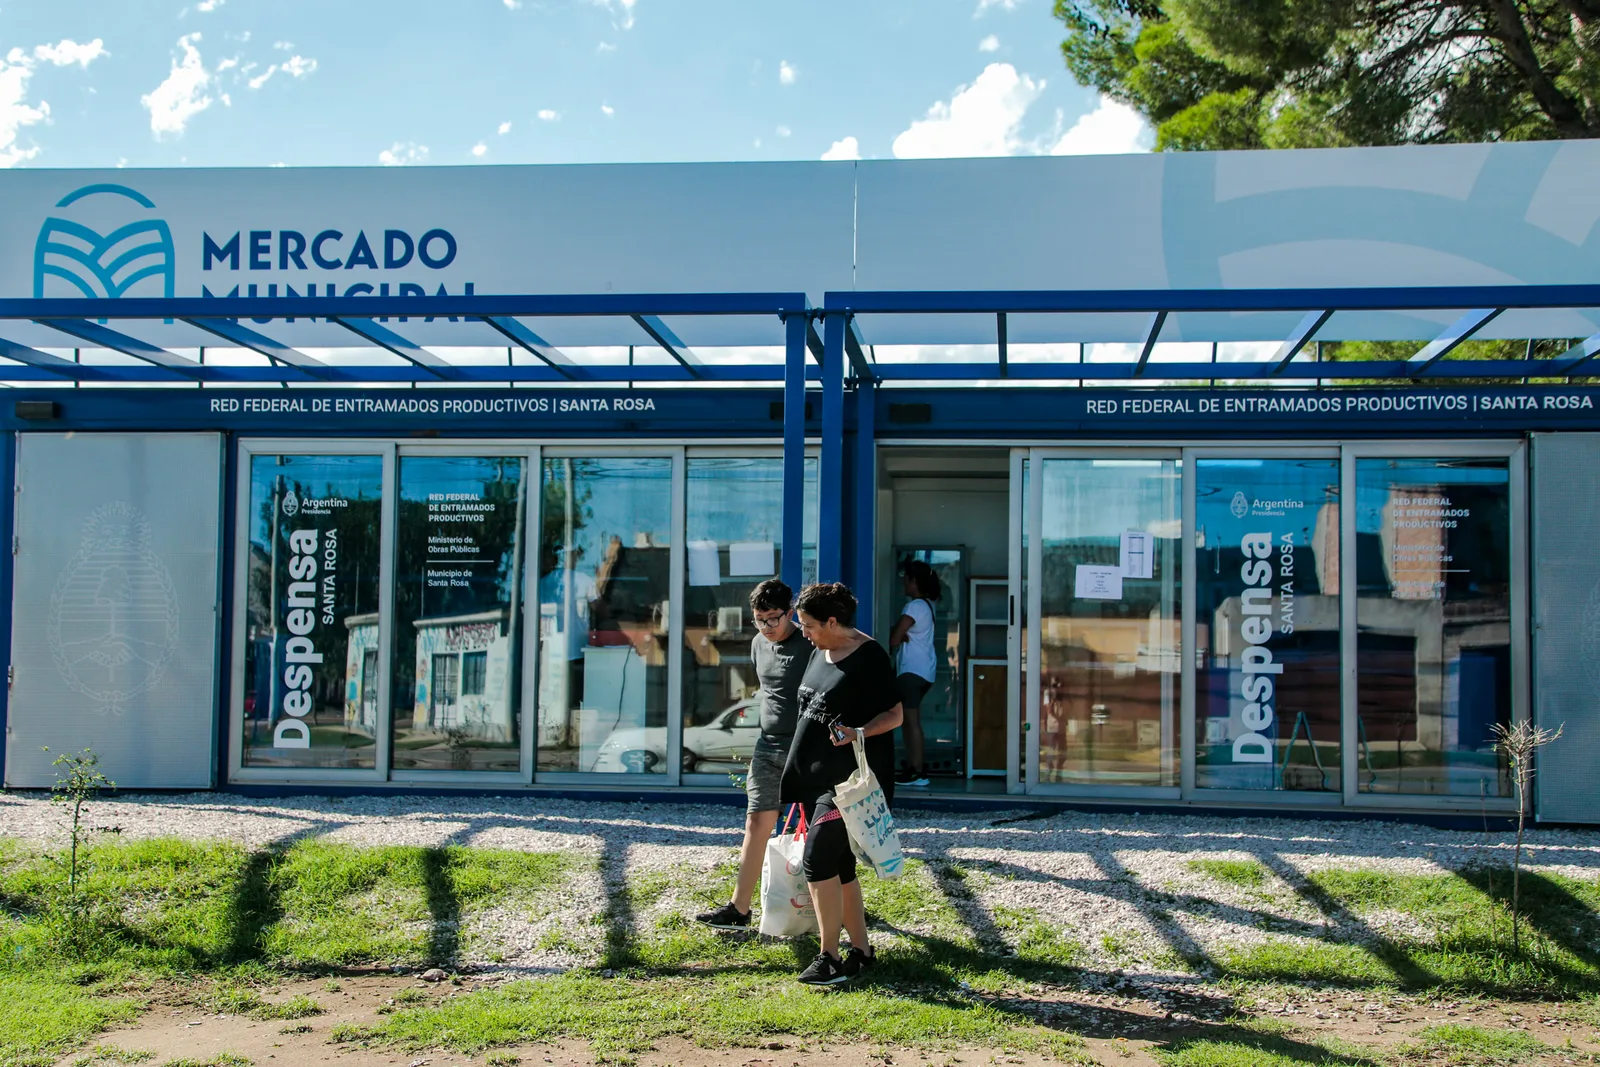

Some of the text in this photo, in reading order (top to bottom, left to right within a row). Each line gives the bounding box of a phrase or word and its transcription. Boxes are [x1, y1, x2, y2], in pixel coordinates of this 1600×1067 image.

[202, 228, 458, 271] MERCADO
[210, 398, 240, 412] RED
[243, 398, 309, 412] FEDERAL
[312, 398, 332, 412] DE
[335, 398, 439, 413] ENTRAMADOS
[442, 398, 549, 413] PRODUCTIVOS
[559, 398, 609, 412] SANTA
[613, 398, 656, 411] ROSA
[1086, 399, 1118, 414] RED
[1122, 399, 1195, 414] FEDERAL
[1198, 398, 1220, 413] DE
[1224, 397, 1342, 413] ENTRAMADOS
[1346, 396, 1468, 412] PRODUCTIVOS
[1480, 396, 1539, 410] SANTA
[1543, 395, 1593, 409] ROSA
[428, 493, 480, 501] RED FEDERAL
[302, 498, 348, 510] Argentina
[1252, 499, 1304, 511] Argentina
[1392, 498, 1452, 506] RED FEDERAL
[428, 503, 496, 512] DE ENTRAMADOS
[1392, 509, 1470, 517] DE ENTRAMADOS
[428, 514, 485, 522] PRODUCTIVOS
[1393, 520, 1458, 528] PRODUCTIVOS
[428, 536, 473, 544] Ministerio de
[427, 545, 480, 553] Obras Públicas
[322, 528, 338, 625] SANTA ROSA
[427, 569, 473, 578] Municipio de
[427, 579, 470, 587] Santa Rosa
[1280, 532, 1294, 635] SANTA ROSA
[273, 529, 323, 749] Despensa
[1231, 532, 1284, 763] Despensa
